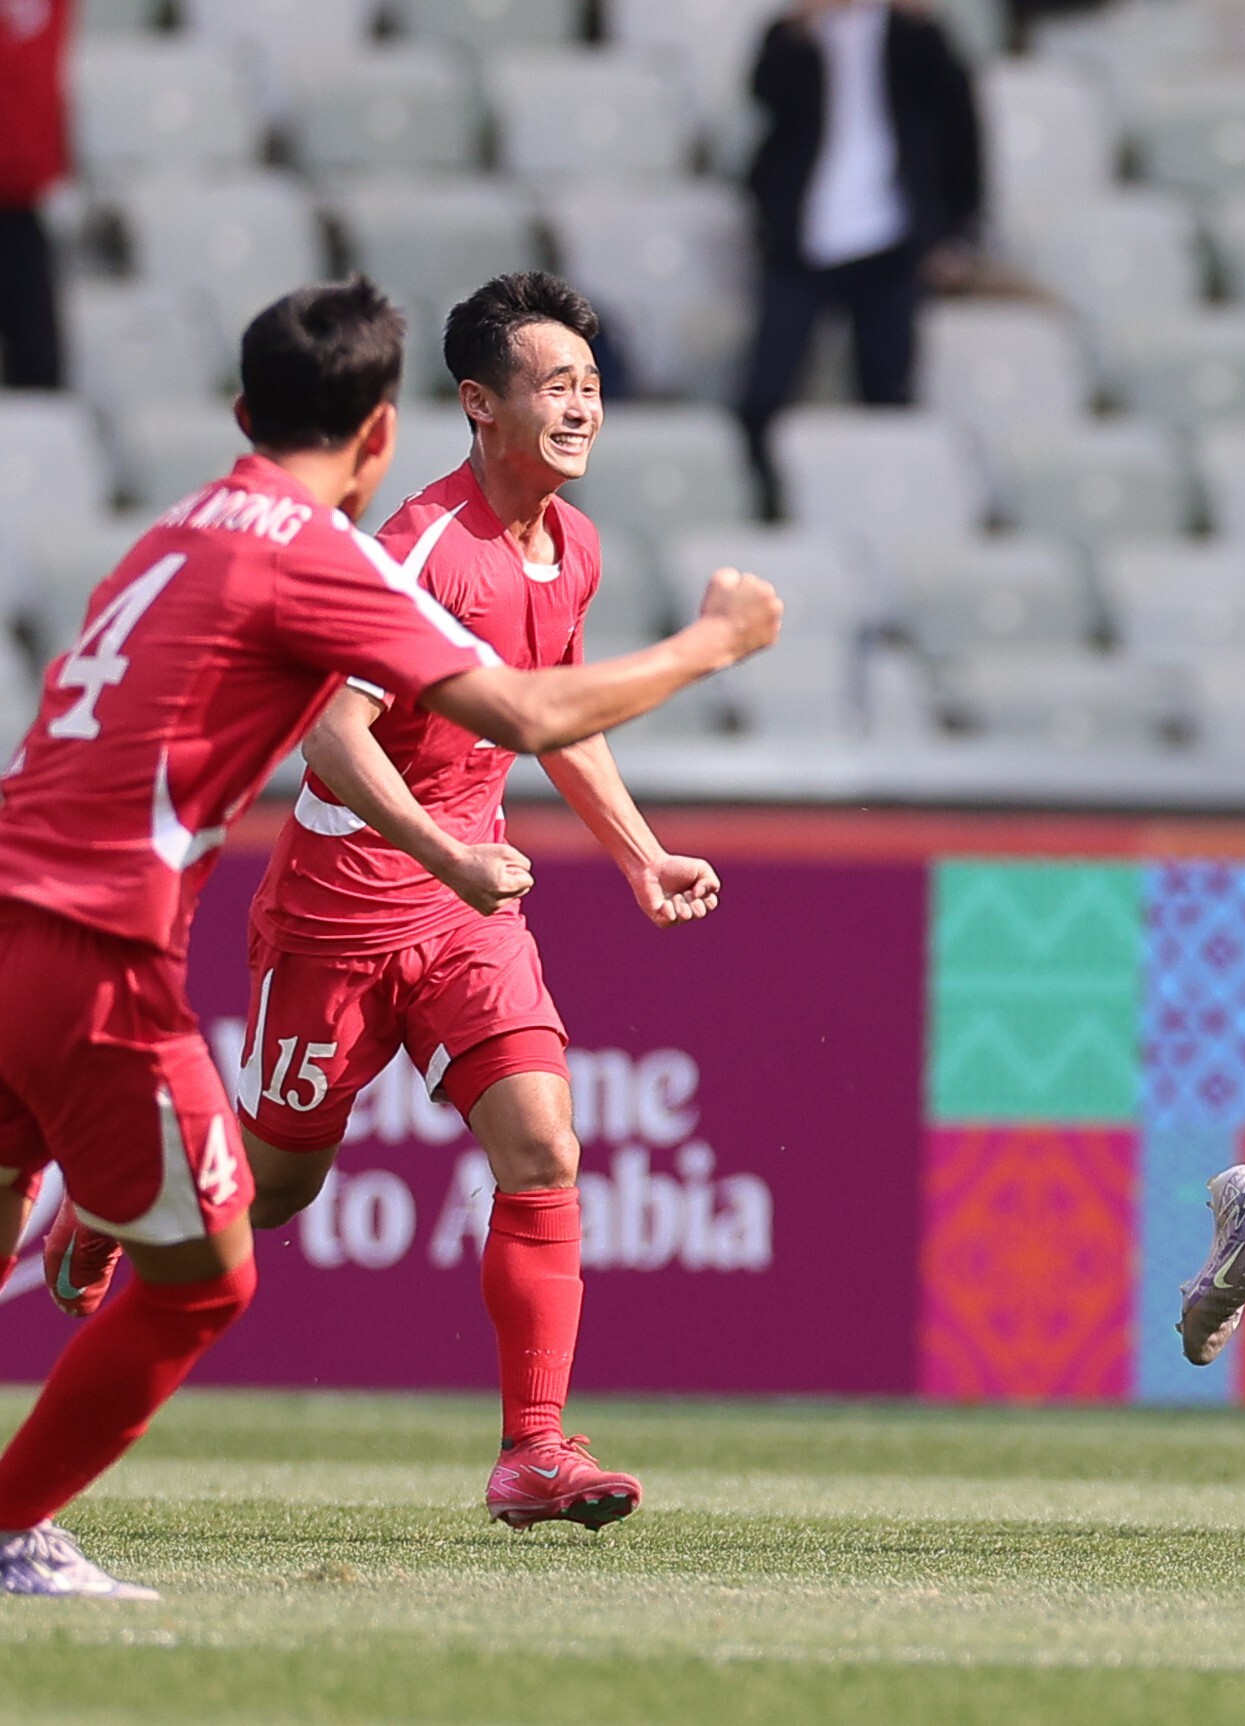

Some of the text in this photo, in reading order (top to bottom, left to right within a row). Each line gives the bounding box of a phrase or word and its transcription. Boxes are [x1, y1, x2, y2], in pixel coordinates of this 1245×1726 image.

[48, 552, 188, 739] 4
[262, 1036, 338, 1111] 15
[199, 1114, 239, 1205] 4
[302, 1140, 774, 1272] to Aabia
